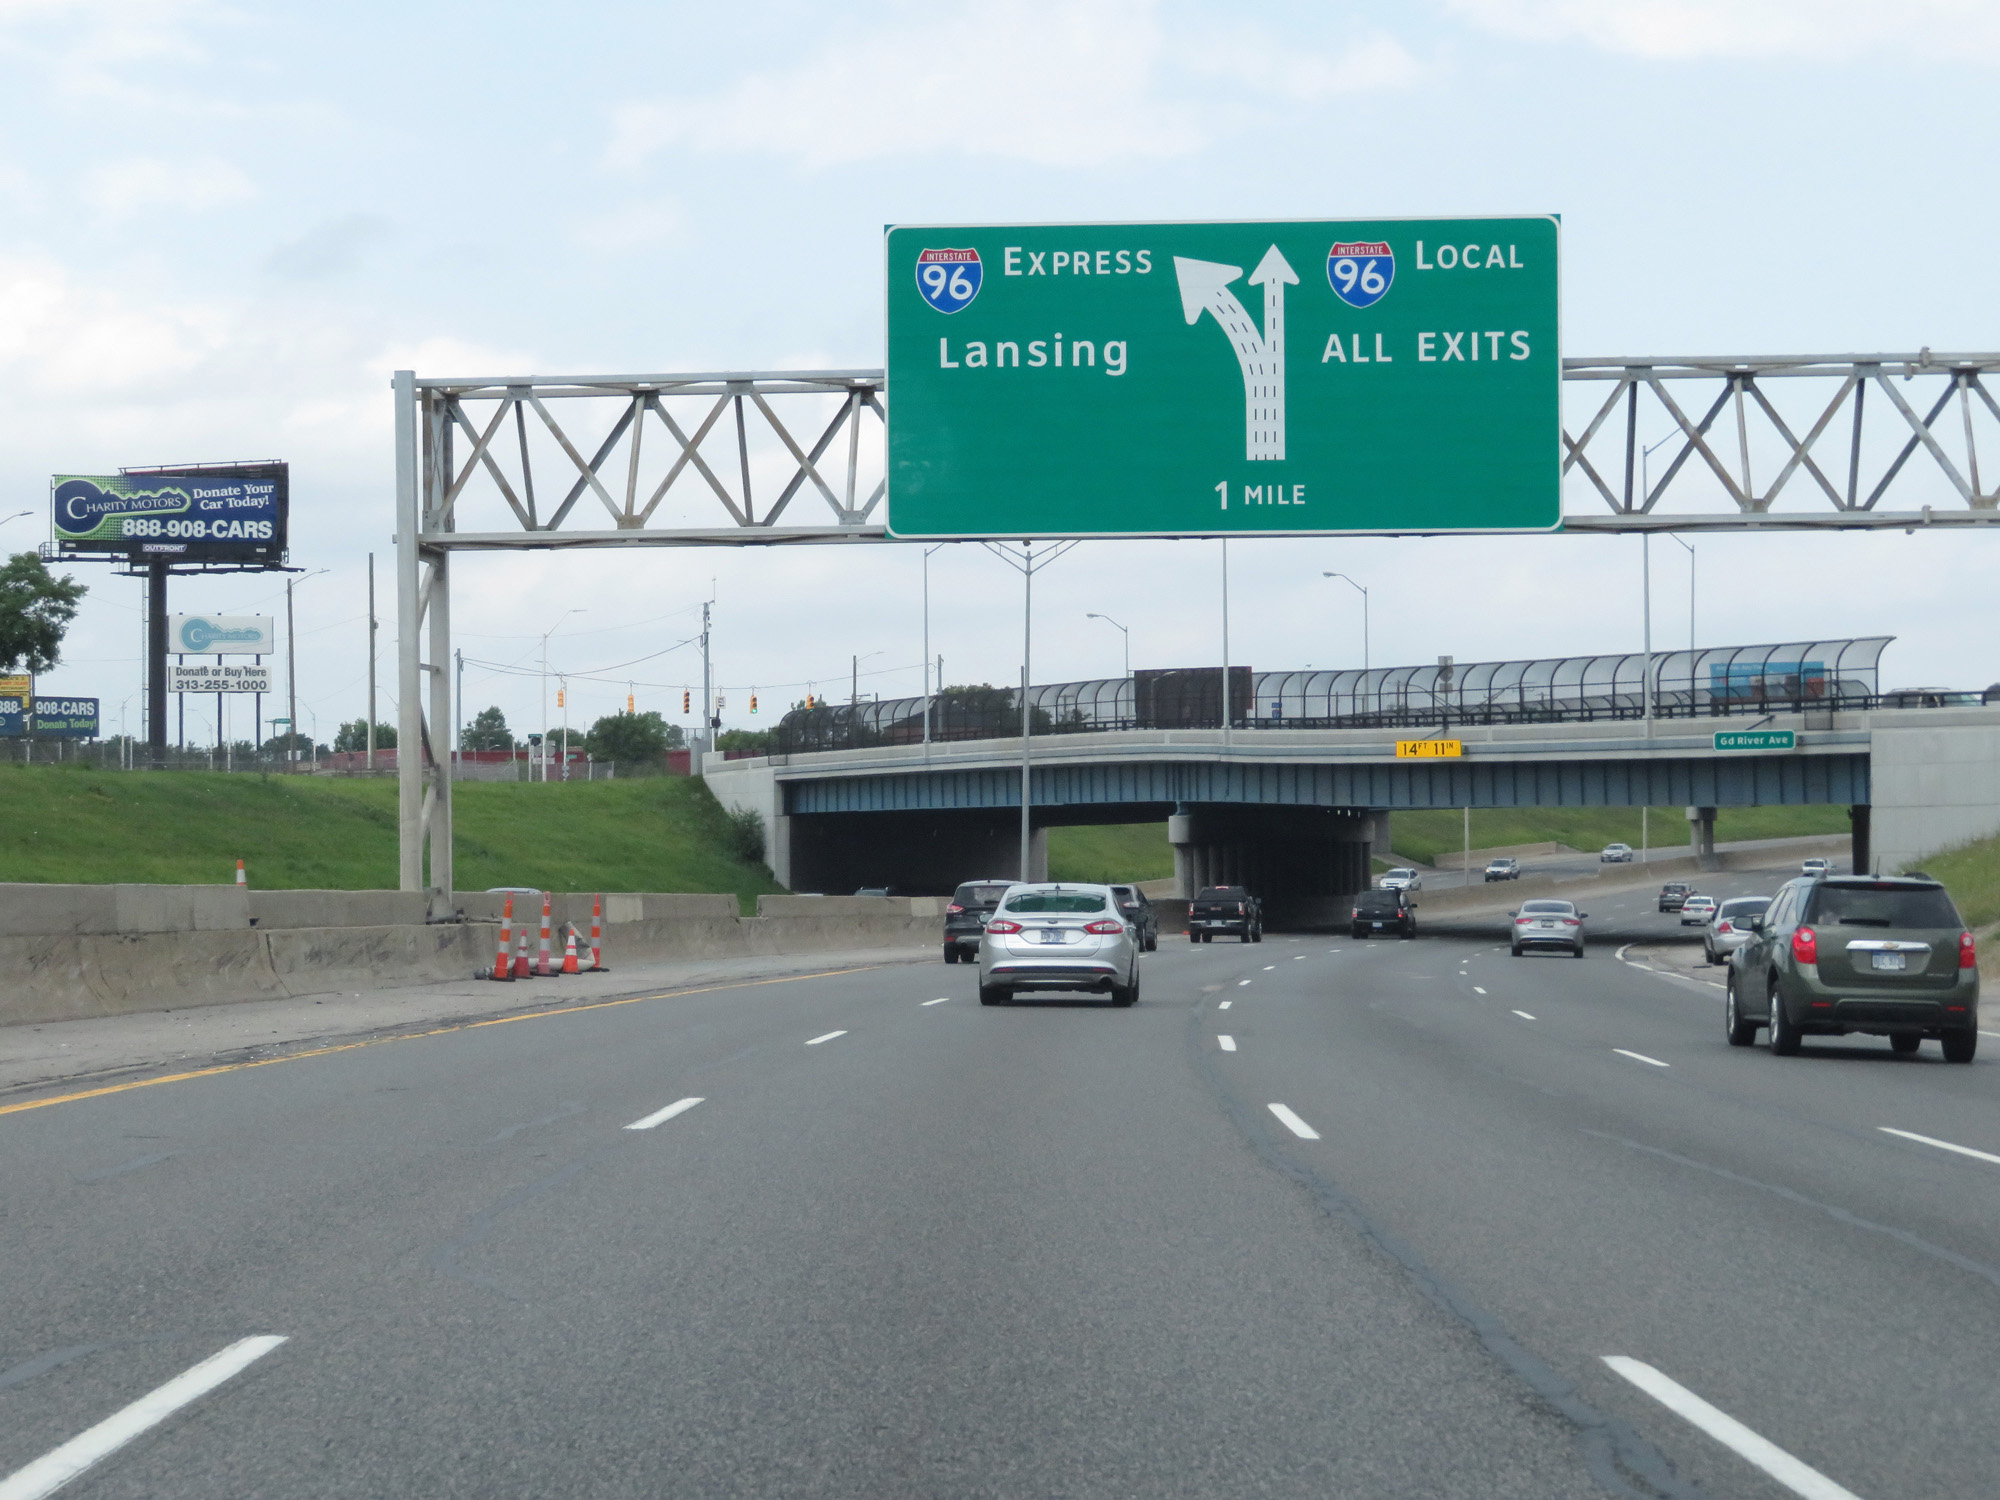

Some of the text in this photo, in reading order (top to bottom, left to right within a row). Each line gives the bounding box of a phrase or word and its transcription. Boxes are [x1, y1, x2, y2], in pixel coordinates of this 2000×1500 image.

[926, 252, 972, 262] INTERSTATE
[1337, 246, 1384, 255] INTERSTATE
[1416, 240, 1524, 270] LOCAL
[1004, 246, 1152, 276] EXPRESS
[923, 264, 973, 301] 96
[1333, 258, 1385, 295] 96
[940, 332, 1128, 376] Lansing
[1321, 330, 1531, 363] ALL EXITS
[192, 484, 275, 499] Donate Your
[1214, 480, 1306, 510] 1 MILE
[66, 496, 182, 520] CHARITY MOTORS
[200, 495, 270, 510] Car Today!
[122, 518, 274, 539] 888-908-CARS
[175, 665, 267, 679] Donate or Buy Here
[175, 680, 267, 690] 313-255-1000
[35, 701, 95, 716] 908-CARS
[37, 718, 97, 730] Donate Today!
[1720, 735, 1788, 746] Gd River Ave
